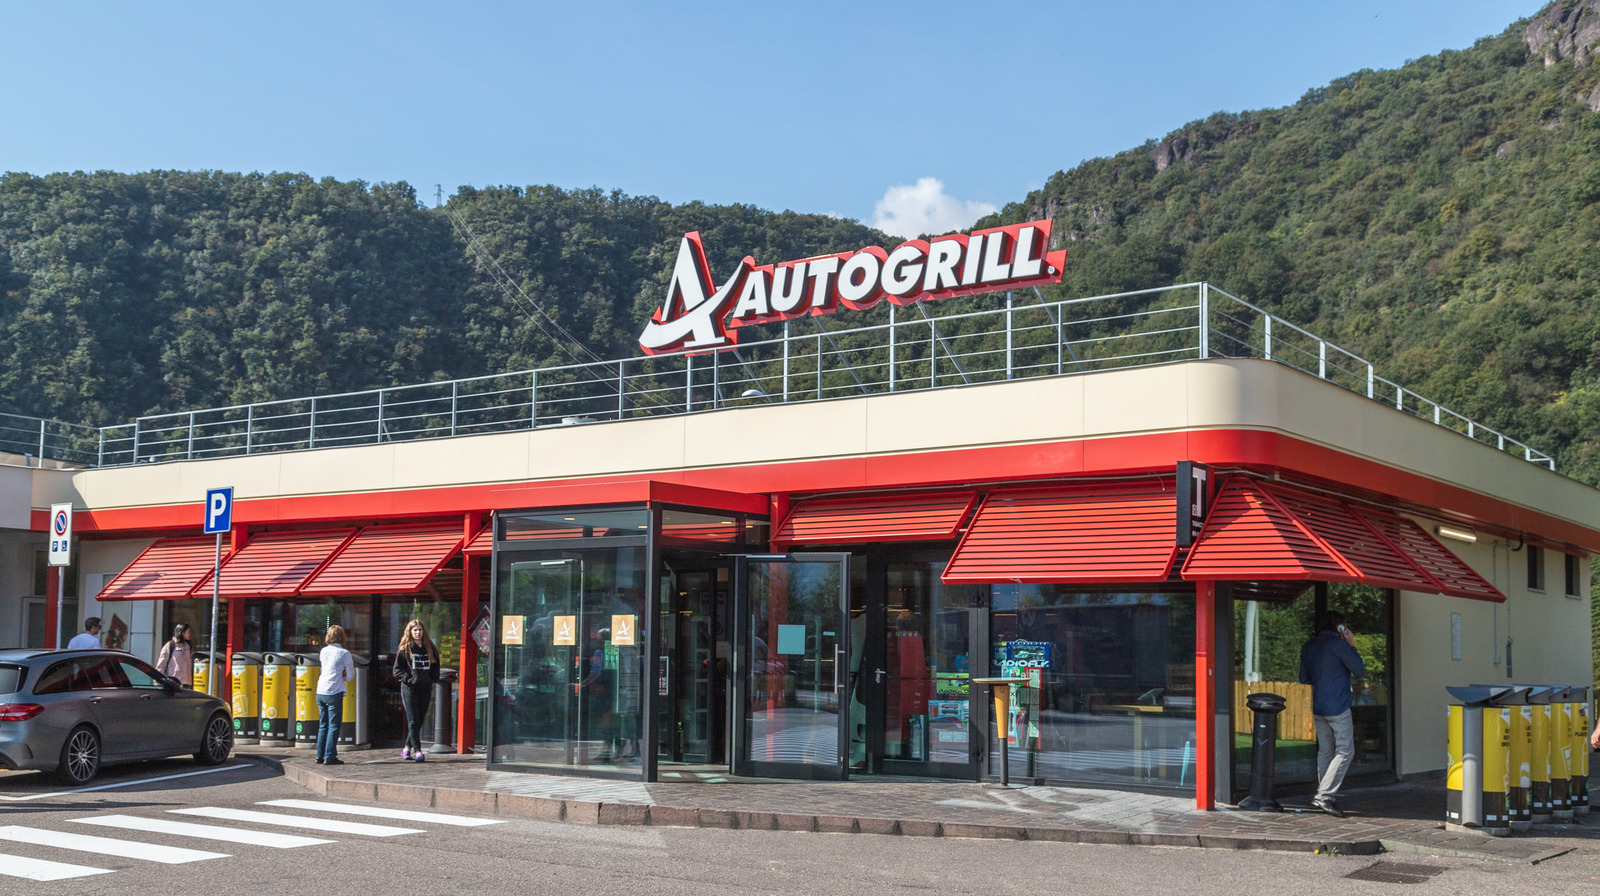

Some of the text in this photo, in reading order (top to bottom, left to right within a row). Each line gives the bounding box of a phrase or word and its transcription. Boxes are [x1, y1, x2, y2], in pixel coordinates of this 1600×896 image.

[732, 226, 1042, 319] AUTOGRILL
[209, 492, 227, 529] P
[1192, 467, 1206, 517] T
